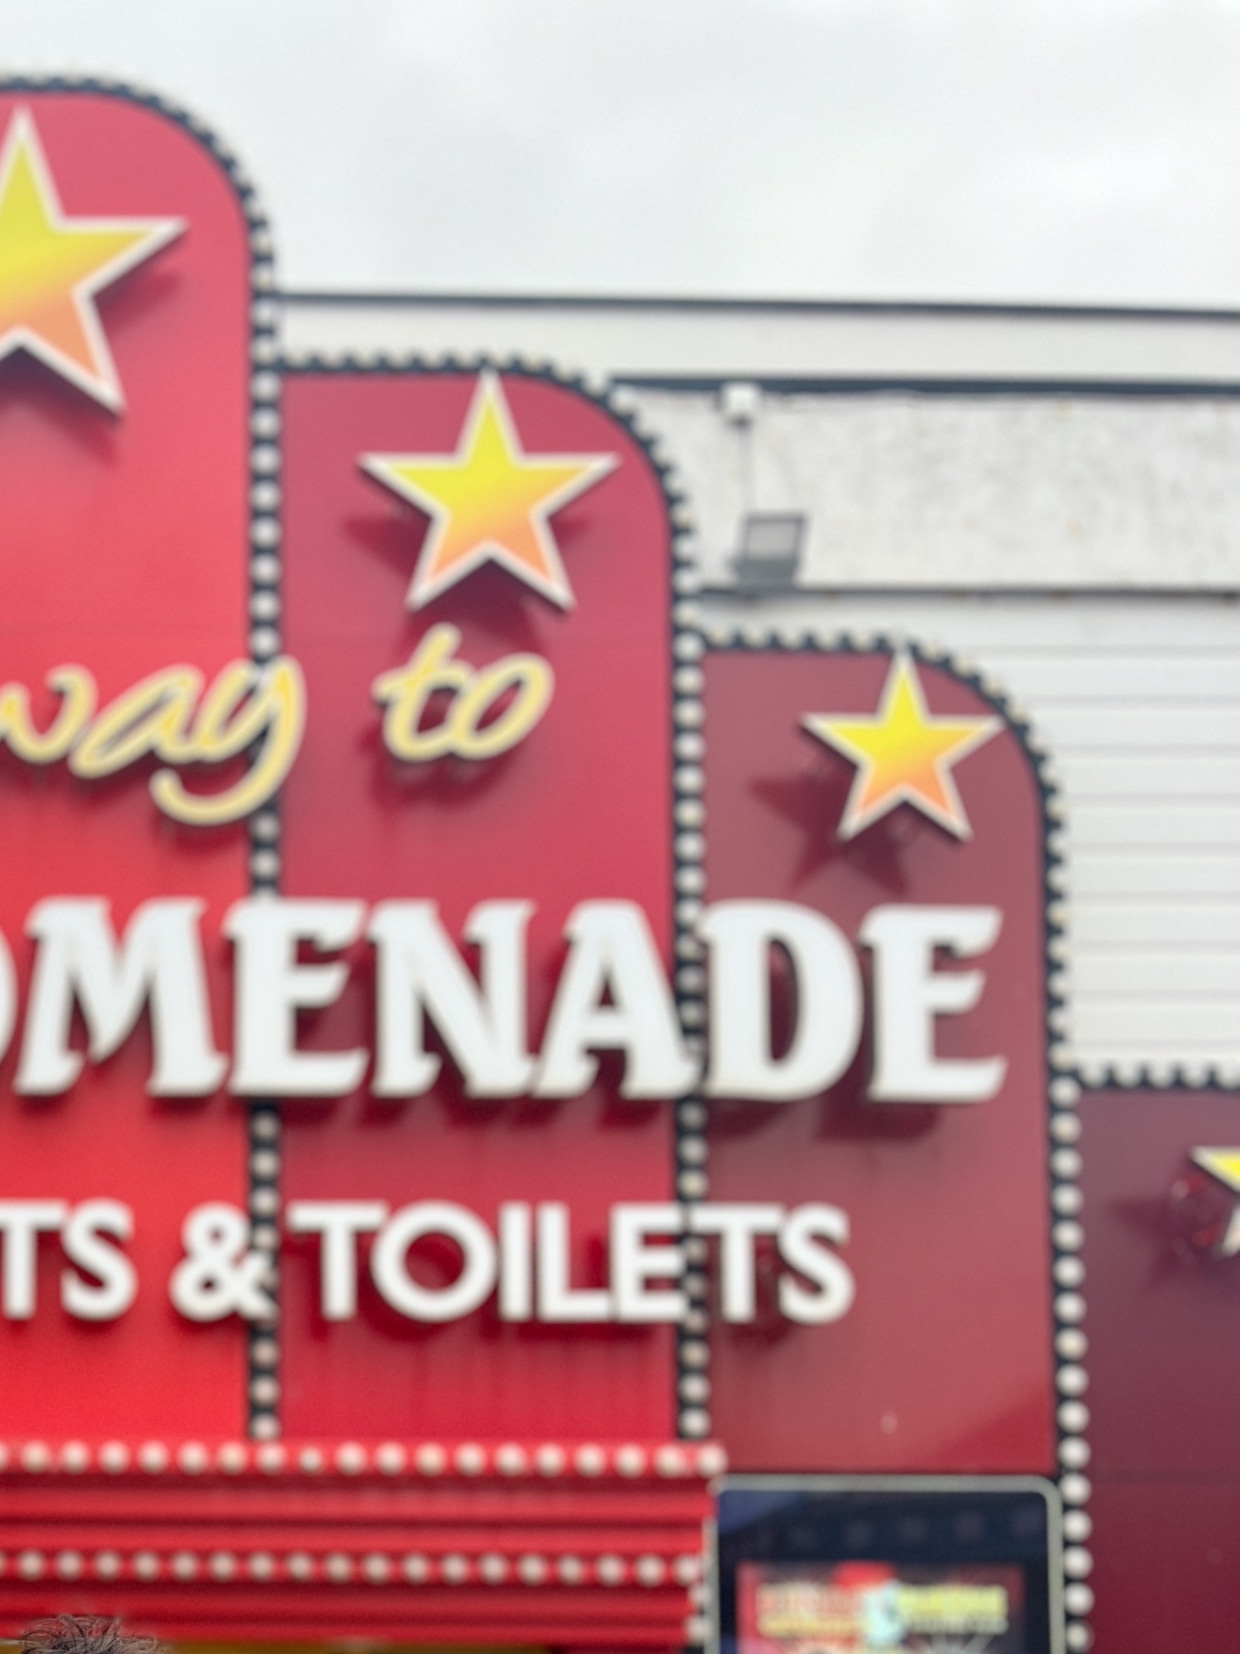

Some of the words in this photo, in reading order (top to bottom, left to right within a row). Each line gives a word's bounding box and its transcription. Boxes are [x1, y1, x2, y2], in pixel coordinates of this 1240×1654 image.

[373, 622, 555, 764] to
[169, 1202, 279, 1324] &
[286, 1201, 856, 1325] TOILETS
